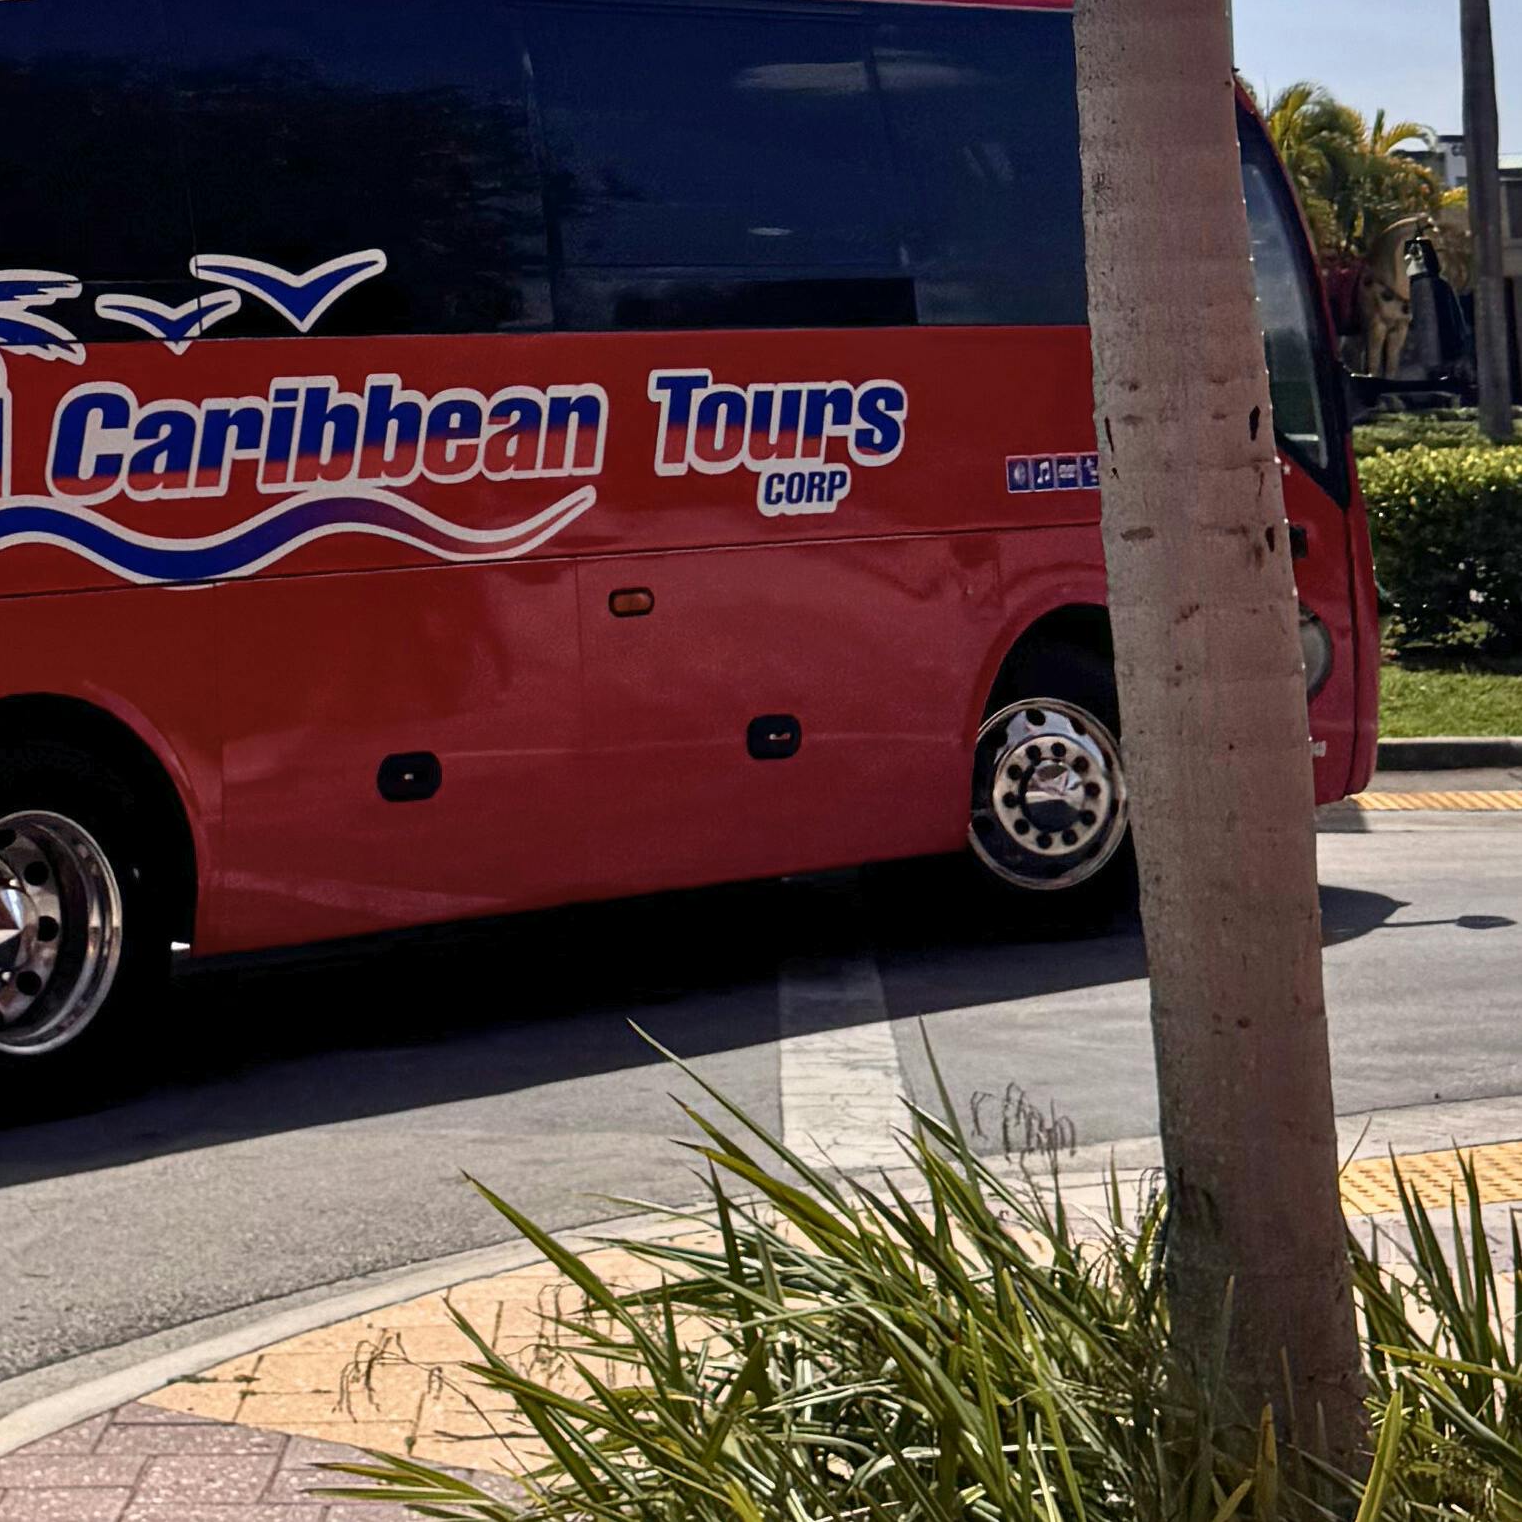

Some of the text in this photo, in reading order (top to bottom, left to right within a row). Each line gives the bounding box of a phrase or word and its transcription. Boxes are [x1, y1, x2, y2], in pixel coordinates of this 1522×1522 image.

[49, 378, 605, 500] Caribbean
[652, 371, 906, 470] Tours
[761, 467, 849, 510] CORP
